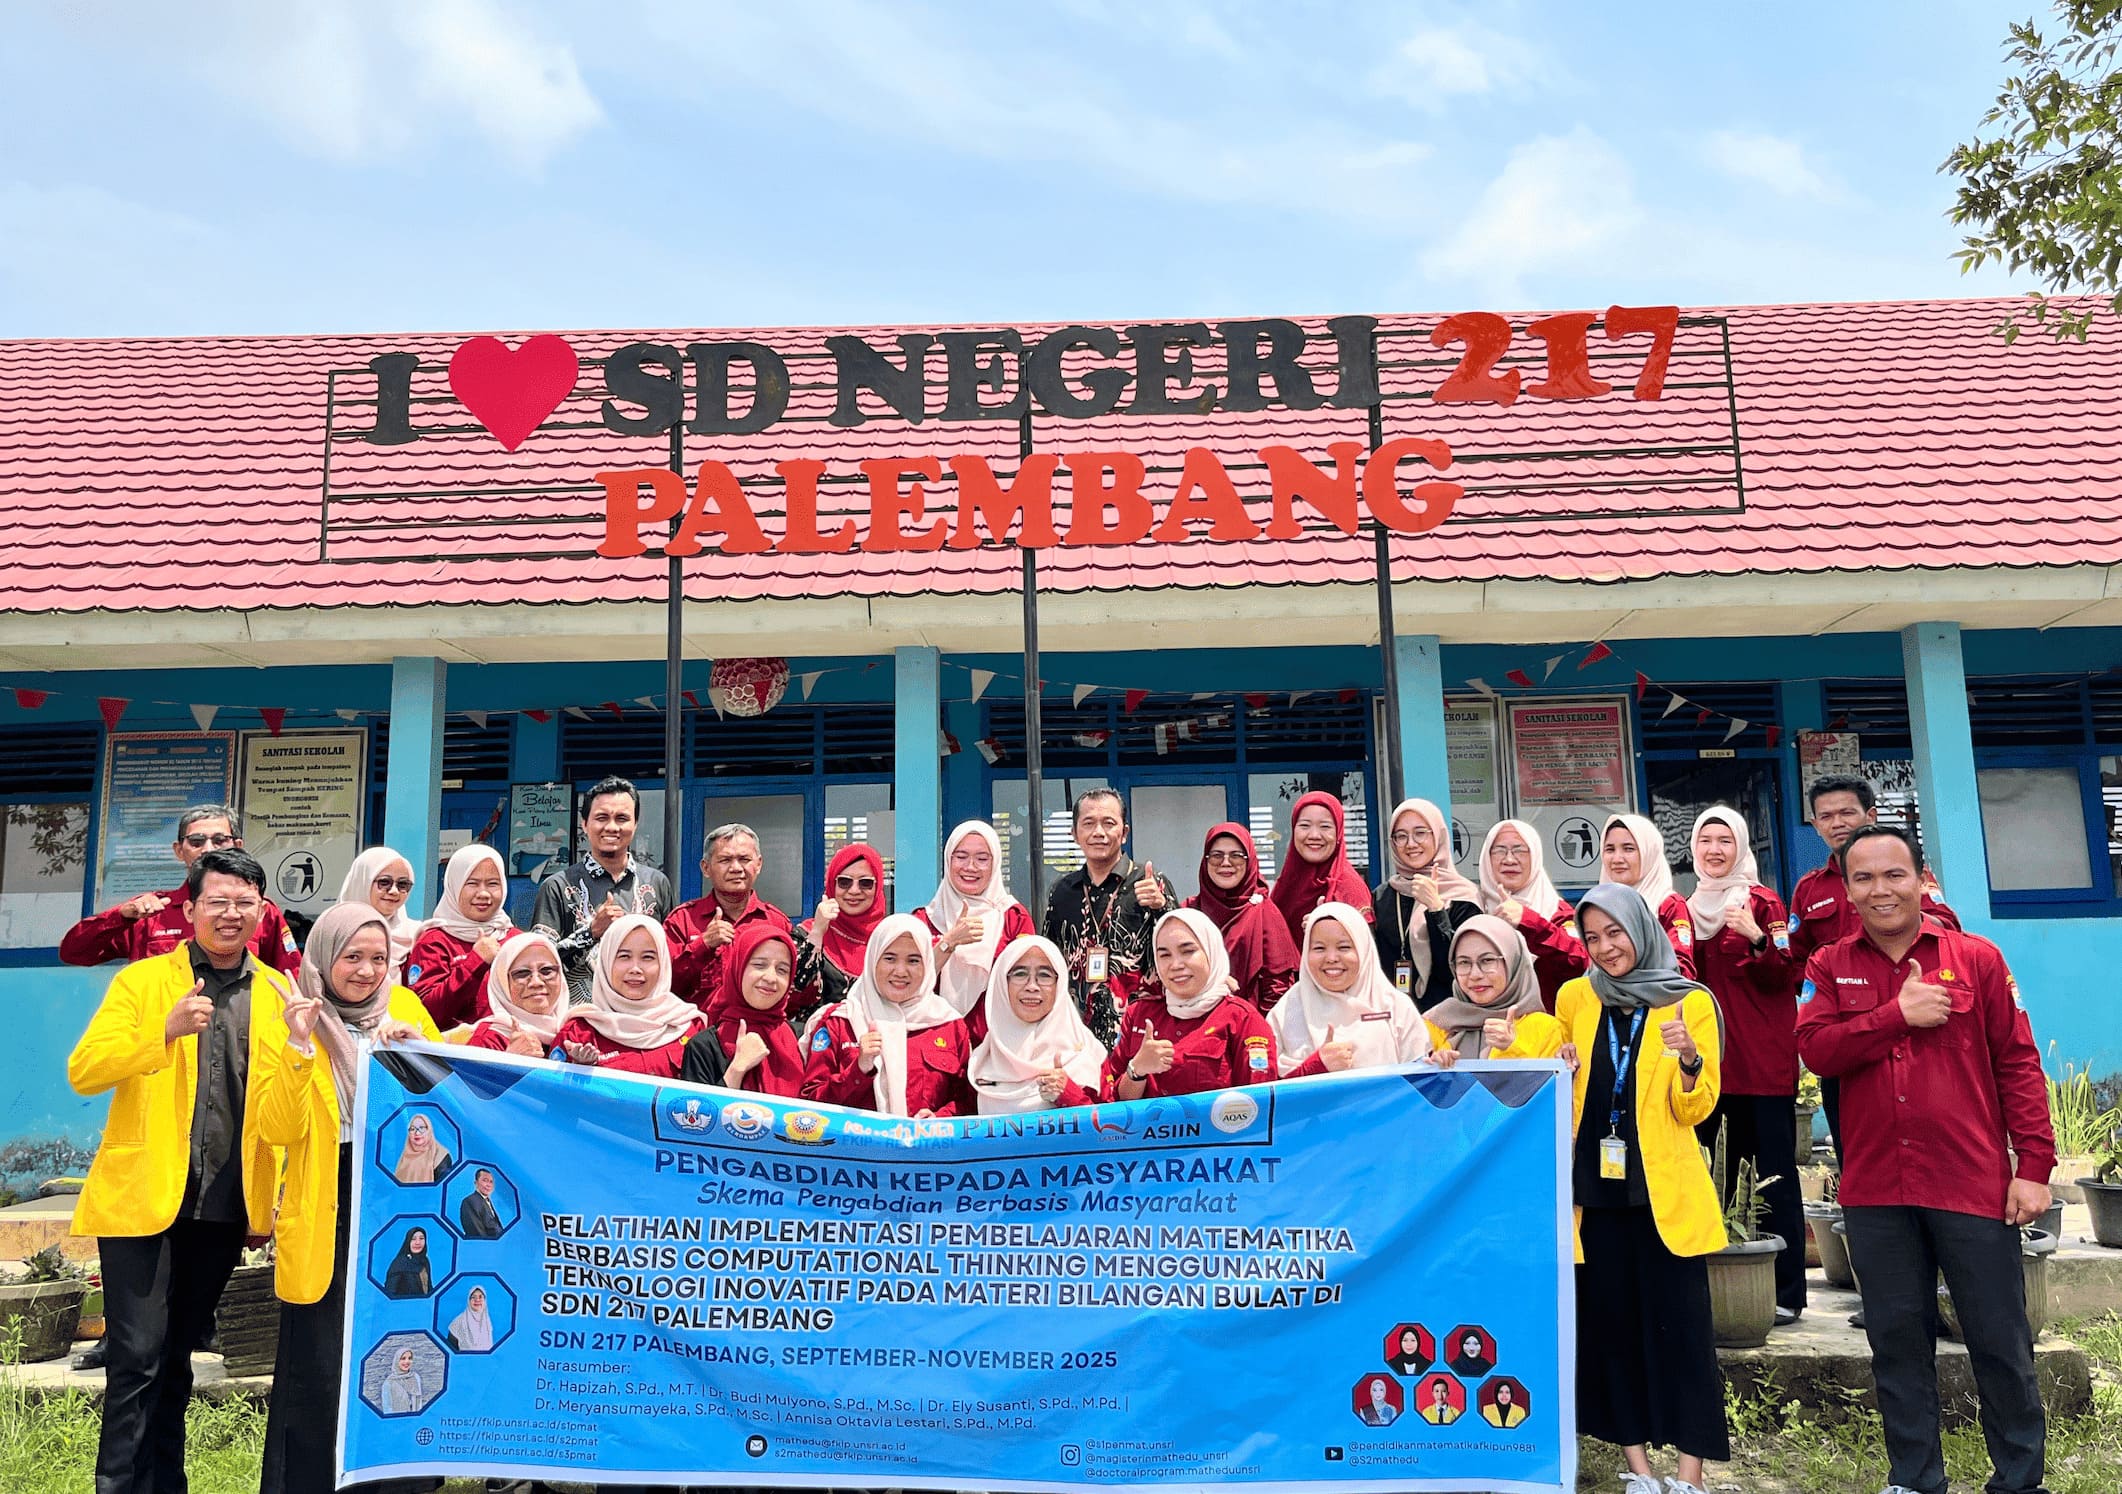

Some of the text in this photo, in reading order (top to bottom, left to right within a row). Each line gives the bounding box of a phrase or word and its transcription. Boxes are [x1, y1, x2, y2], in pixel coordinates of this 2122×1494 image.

[365, 305, 1681, 445] I SD NEGERI 217
[595, 437, 1465, 558] PALEMBANG
[1444, 712, 1479, 721] EKOLAH
[1525, 712, 1607, 723] SANITASI SEKOLAH
[262, 746, 345, 757] SANITASI SEKOLAH
[960, 1112, 1081, 1141] PTN-BH
[1221, 1112, 1249, 1123] AQAS
[1142, 1122, 1201, 1141] ASIIN
[886, 1138, 954, 1150] REUTASI
[655, 1150, 1282, 1191] PENGABDIAN KEPADA MASYARAKAT
[697, 1182, 1237, 1220] Skema Pengabdian Berbasis Masyarakat
[541, 1213, 1355, 1253] PELATIHAN IMPLEMENTASI PEMBELAJARAN MATEMATIKA
[545, 1236, 1325, 1281] BERBASIS COMPUTATIONAL THINKING MENGGUNAKAN
[545, 1264, 1343, 1309] TEKNOLOGI INOVATIF PADA MATERI BILANGAN BULAT DI
[540, 1292, 836, 1332] SDN 217 PALEMBANG
[539, 1330, 1118, 1370] SDN 217 PALEMBANG, SEPTEMBER-NOVEMBER 2025
[537, 1358, 631, 1375] Narasumber:
[536, 1378, 556, 1392] Dr.
[559, 1380, 621, 1396] Hapizah,
[624, 1381, 665, 1397] S.Pd.,
[668, 1383, 699, 1396] M.T.
[708, 1386, 728, 1400] Dr.
[731, 1391, 762, 1405] Budi
[766, 1393, 831, 1411] Mulyono,
[833, 1398, 873, 1412] S.Pd.,
[877, 1399, 916, 1412] M.Sc.
[928, 1400, 949, 1413] Dr.
[952, 1400, 973, 1416] Ely
[976, 1399, 1035, 1413] Susanti,
[1039, 1397, 1079, 1411] S.Pd.,
[535, 1397, 556, 1412] Dr.
[558, 1400, 691, 1418] Meryansumayeka,
[695, 1403, 734, 1417] S.Pd.,
[736, 1407, 774, 1422] M.Sc.
[784, 1410, 833, 1426] Annisa
[836, 1416, 893, 1428] Oktavia
[896, 1416, 951, 1430] Lestari,
[954, 1417, 994, 1430] S.Pd.,
[997, 1416, 1037, 1429] M.Pd.
[440, 1416, 598, 1432] https://fkip.unsri.ac.id/s1pmat
[439, 1431, 598, 1447] https://fkip.unsri.ac.id/s2pmat
[775, 1436, 906, 1451] mathedu@fkip.unsri.ac.id
[438, 1445, 597, 1461] https://fkip.unsri.ac.id/s3pmat
[774, 1449, 919, 1464] s2mathedu@fkip.unsri.ac.id
[1349, 1455, 1420, 1467] @S2mathedu
